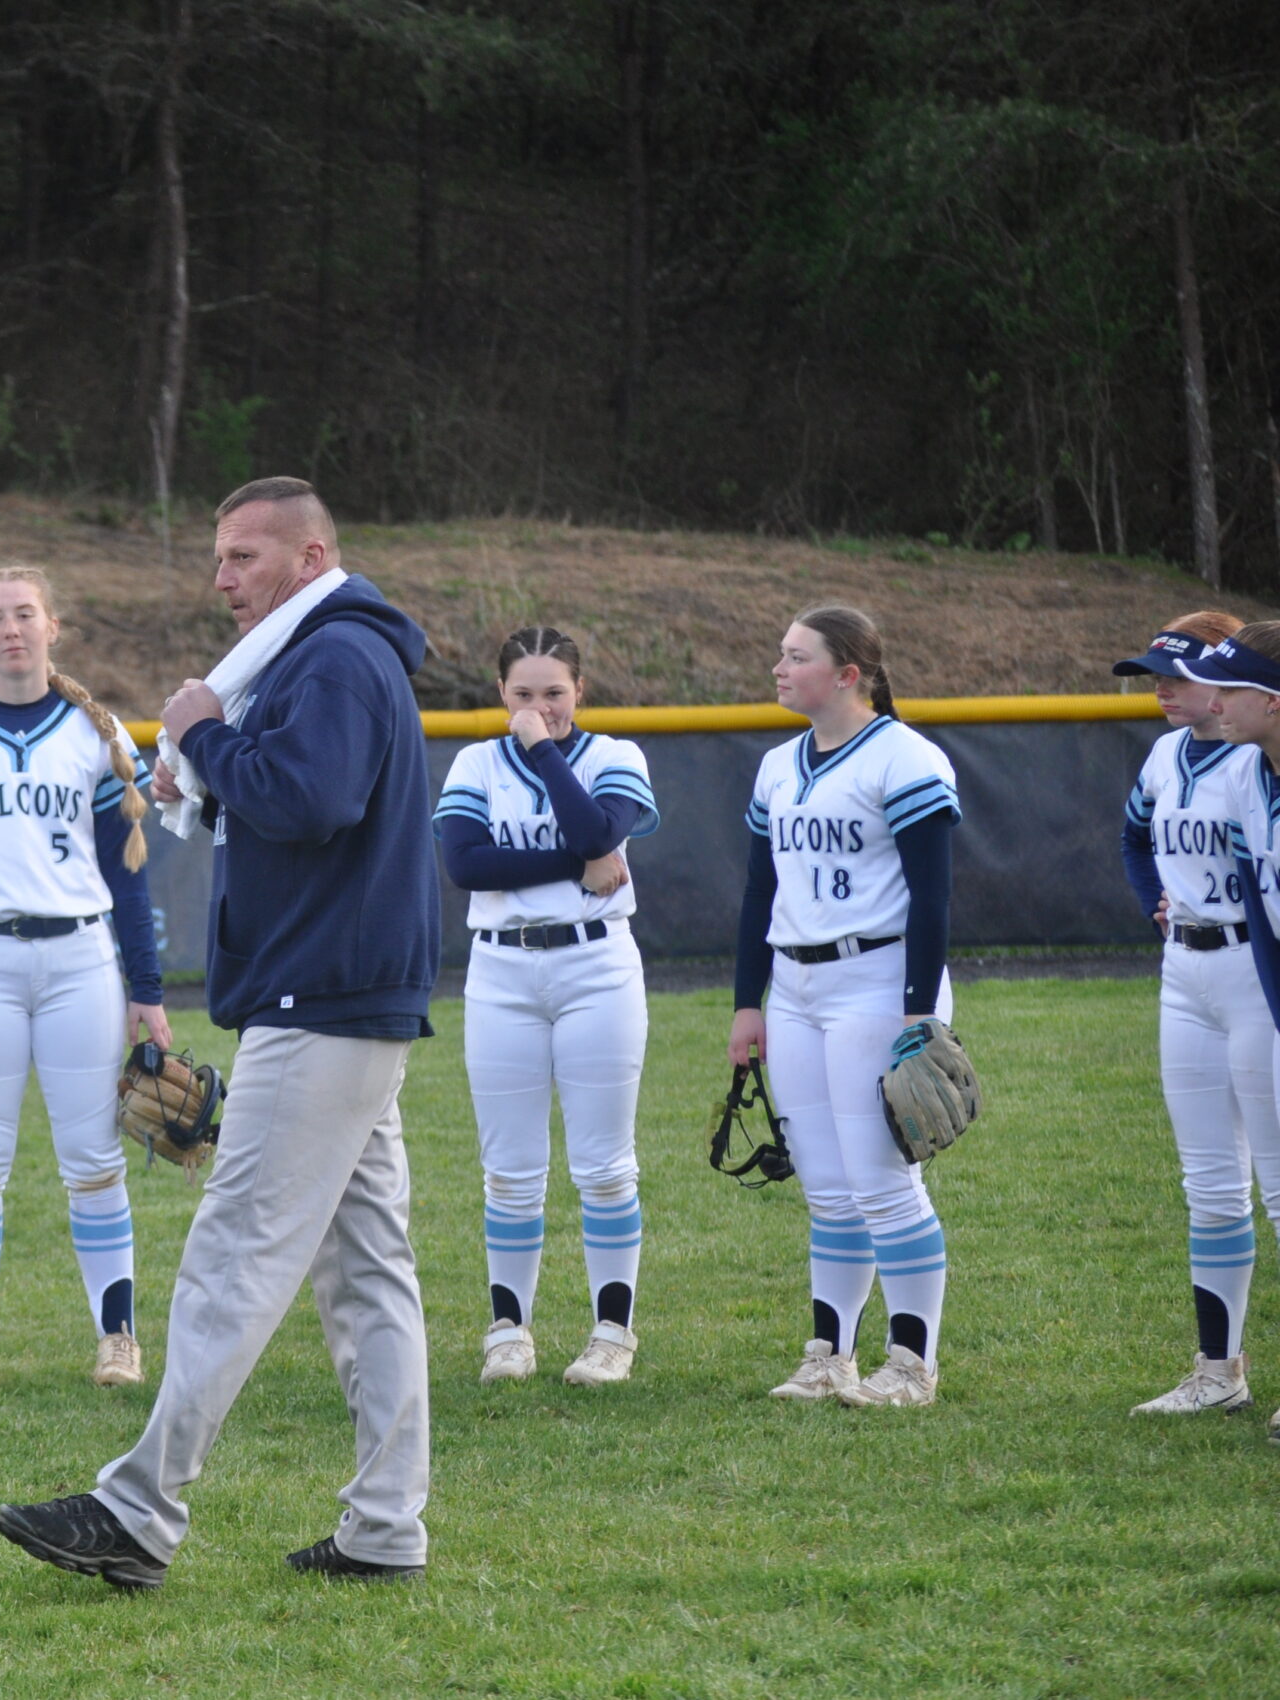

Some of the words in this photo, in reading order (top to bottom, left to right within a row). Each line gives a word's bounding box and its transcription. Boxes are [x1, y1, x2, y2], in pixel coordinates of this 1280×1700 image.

[50, 832, 71, 864] 5
[770, 816, 864, 853] LCONS
[1151, 819, 1230, 855] LCON
[810, 865, 853, 902] 18
[1202, 871, 1243, 905] 20
